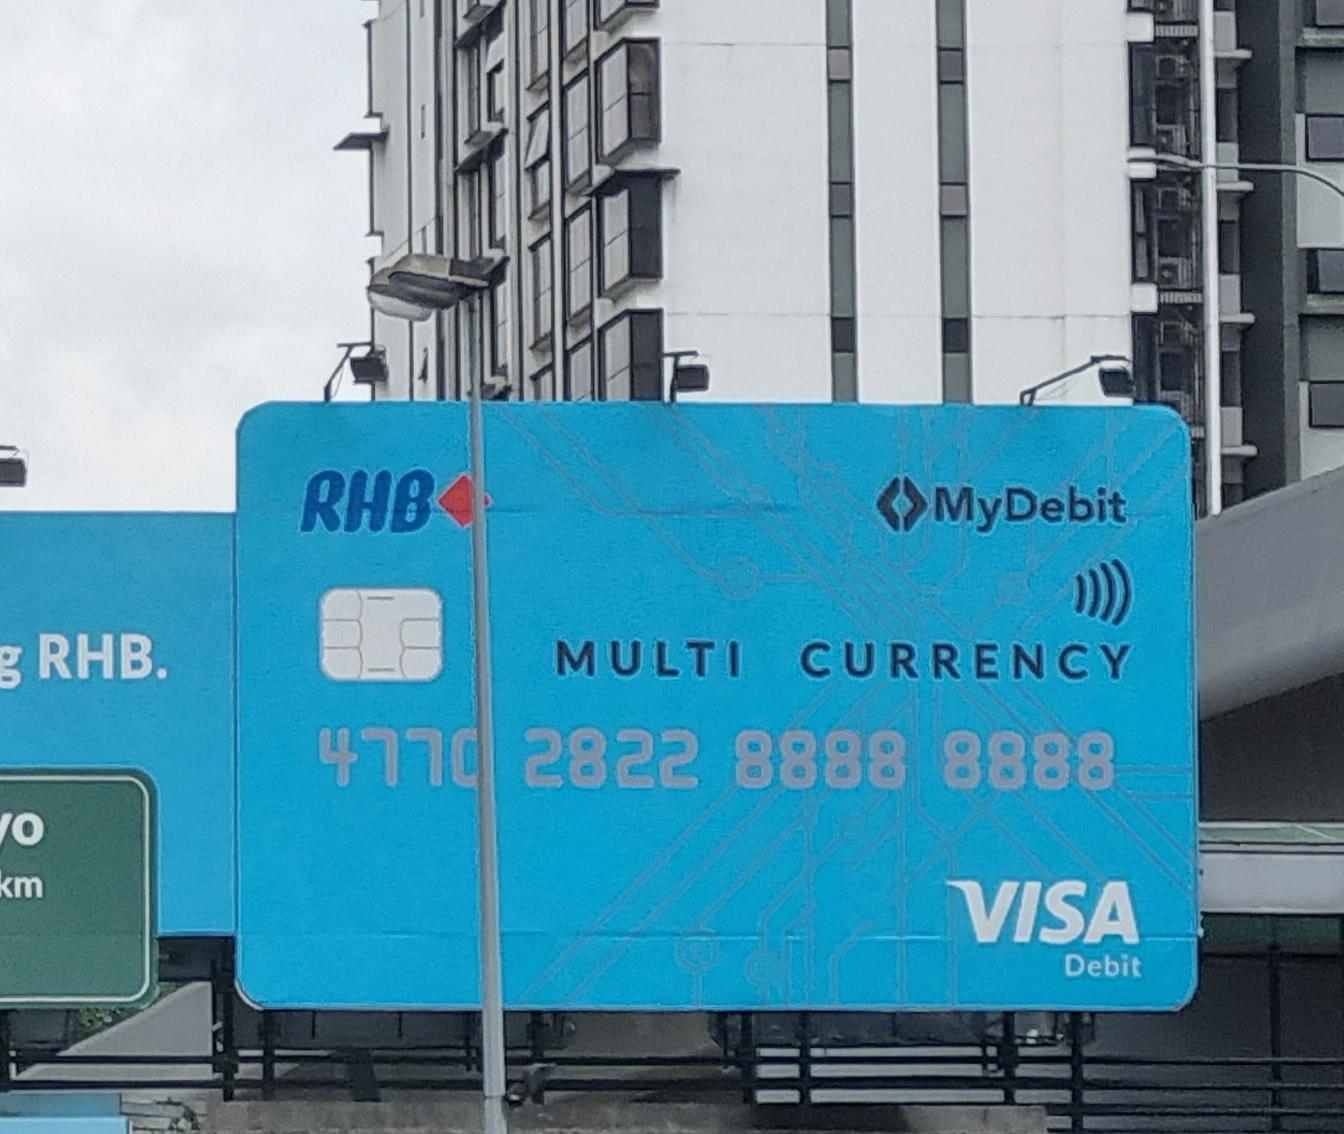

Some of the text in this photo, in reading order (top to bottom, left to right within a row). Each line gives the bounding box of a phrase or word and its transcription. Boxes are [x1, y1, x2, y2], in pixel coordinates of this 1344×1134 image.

[300, 469, 435, 534] RHB
[934, 485, 1128, 533] MyDebit
[38, 633, 169, 680] RHB.
[555, 640, 1131, 681] MULTI CURRENCY
[523, 727, 700, 790] 2822
[734, 728, 909, 791] 8888
[942, 729, 1116, 792] 8888
[946, 878, 1141, 946] VISA
[1064, 952, 1142, 979] Debit
